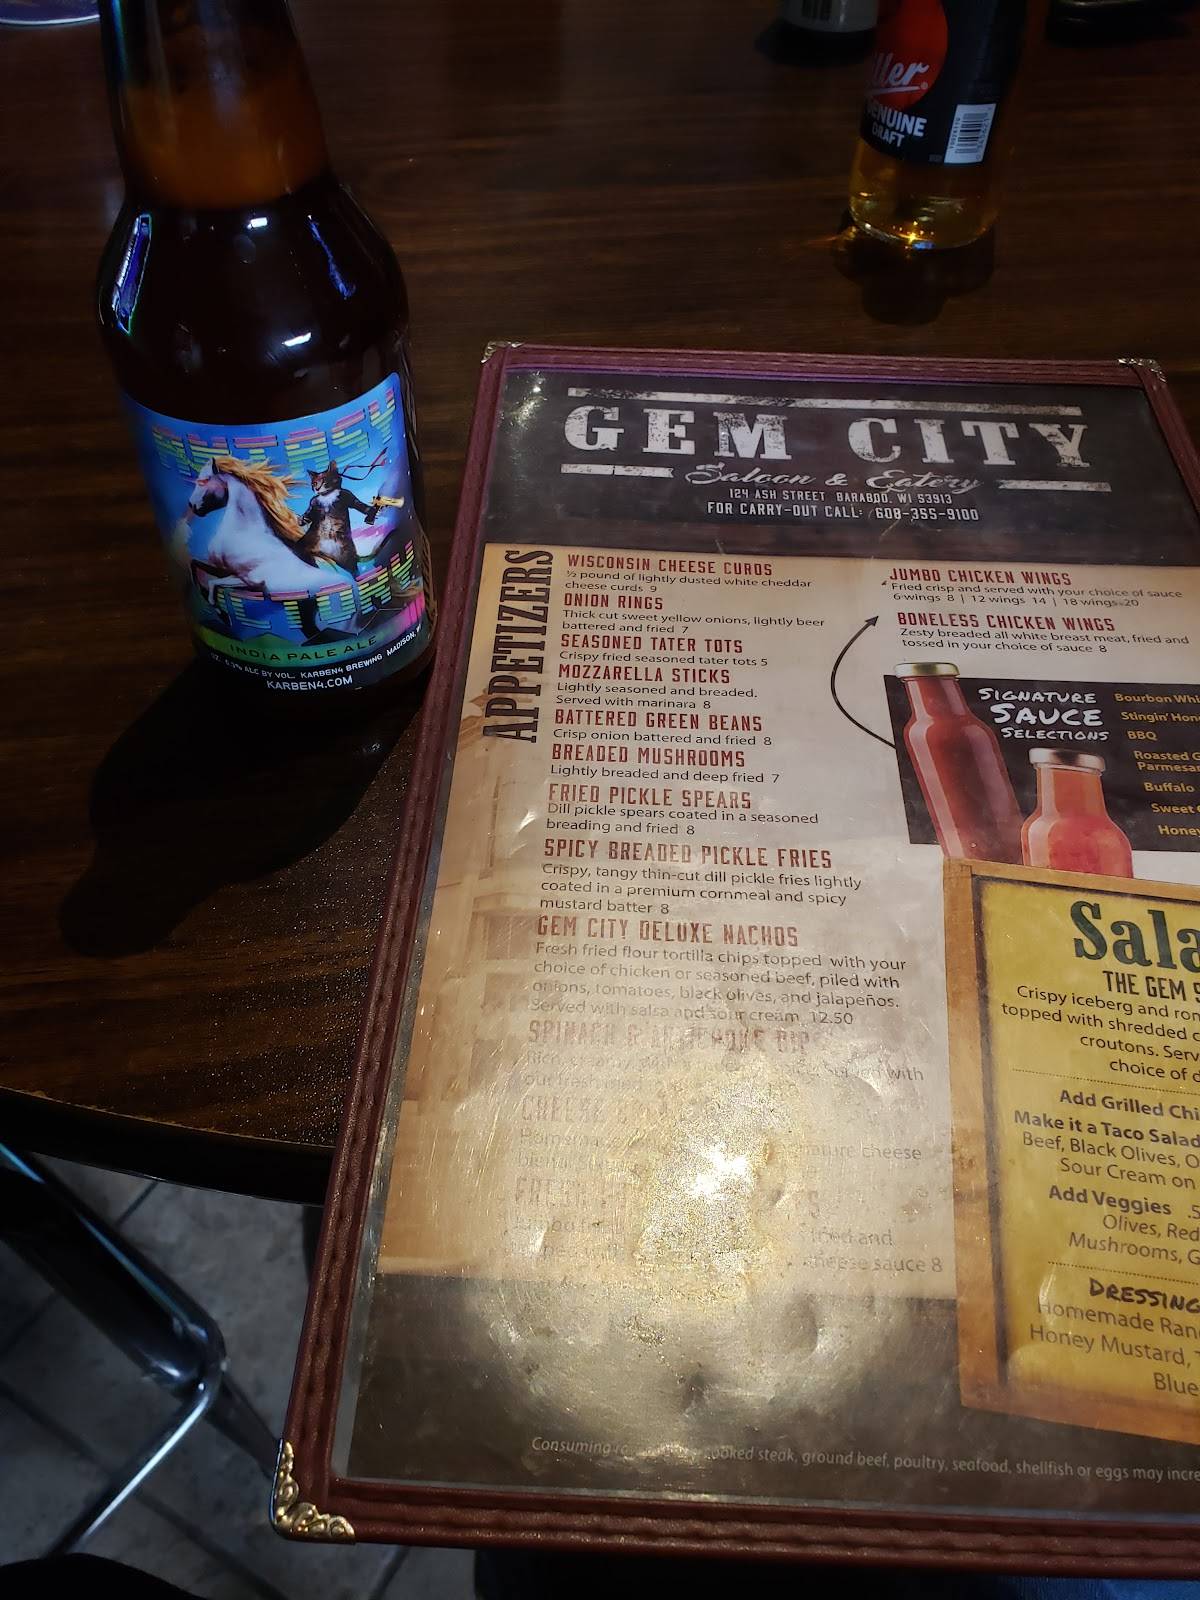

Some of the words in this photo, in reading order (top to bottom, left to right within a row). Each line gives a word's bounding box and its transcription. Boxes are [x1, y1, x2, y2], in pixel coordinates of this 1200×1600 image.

[872, 123, 905, 148] DRAFT
[564, 405, 792, 460] GEM
[848, 417, 1091, 468] CITY
[685, 462, 817, 487] Saloon
[824, 474, 849, 487] &
[866, 470, 985, 494] Eatery
[729, 488, 750, 500] 124
[754, 489, 778, 501] ASH
[783, 490, 826, 502] STREET
[898, 494, 912, 505] WI
[917, 494, 953, 505] 53913
[707, 501, 734, 515] FOR
[740, 503, 818, 518] CARRY-OUT
[824, 506, 863, 519] CALL:
[875, 508, 980, 522] 608-355-9100
[567, 554, 650, 570] WISCONSIN
[658, 559, 716, 574] CHEESE
[723, 562, 772, 576] CURDS
[889, 568, 941, 581] JUMBO
[947, 569, 1015, 583] CHICKEN
[1020, 571, 1071, 585] WINGS
[563, 592, 609, 607] ONION
[617, 595, 663, 610] RINGS
[897, 612, 979, 627] BONELESS
[985, 614, 1056, 630] CHICKEN
[1061, 617, 1115, 631] WINGS
[230, 643, 281, 662] INDIA
[287, 648, 338, 661] PALE
[343, 635, 379, 655] ALE
[261, 670, 274, 678] BY
[300, 665, 344, 680] KARBEN4
[345, 653, 383, 673] BREWING
[386, 631, 417, 657] MADISON,
[483, 549, 554, 743] APPETIZERS
[560, 633, 642, 649] SEASONED
[650, 636, 696, 651] TATER
[704, 638, 742, 653] TOTS
[559, 650, 599, 666] Crispy
[602, 652, 631, 662] fried
[634, 655, 695, 664] seasoned
[698, 657, 729, 665] tater
[732, 657, 757, 666] tots
[760, 658, 768, 666] 5
[266, 675, 354, 691] KARBEN4.COM
[558, 664, 663, 681] MOZZARELLA
[671, 667, 730, 683] STICKS
[557, 682, 602, 696] Lightly
[605, 685, 666, 696] seasoned
[669, 686, 695, 696] and
[698, 687, 757, 697] breaded.
[978, 687, 1097, 704] SIGNATURE
[1114, 693, 1173, 703] Bourbon
[1174, 694, 1200, 704] Whi
[554, 708, 637, 726] BATTERED
[645, 712, 699, 729] GREEN
[708, 714, 762, 731] BEANS
[990, 703, 1103, 726] SAUCE
[553, 728, 587, 741] Crisp
[590, 730, 629, 740] onion
[633, 731, 692, 743] battered
[695, 734, 721, 744] and
[724, 734, 756, 745] fried
[763, 736, 772, 746] 8
[1001, 727, 1110, 742] SELECTIONS
[1127, 730, 1159, 741] BBQ
[551, 743, 628, 762] BREADED
[637, 747, 745, 767] MUSHROOMS
[1133, 750, 1190, 761] Roasted
[550, 764, 598, 778] Lightly
[601, 766, 659, 779] breaded
[662, 770, 689, 780] and
[692, 770, 728, 783] deep
[731, 771, 764, 783] fried
[771, 773, 780, 783] 7
[548, 783, 599, 805] FRIED
[609, 786, 673, 806] PICKLE
[681, 789, 751, 809] SPEARS
[1143, 781, 1196, 793] Buffalo
[1150, 802, 1196, 814] Sweet
[544, 838, 598, 858] SPICY
[608, 841, 691, 862] BREADED
[701, 845, 768, 866] PICKLE
[777, 848, 832, 868] FRIES
[537, 914, 577, 936] GEM
[587, 917, 628, 939] CITY
[639, 920, 713, 943] DELUXE
[723, 924, 798, 947] NACHOS
[1101, 970, 1140, 995] THE
[1144, 975, 1187, 1001] GEM
[1016, 985, 1067, 1006] Crispy
[1071, 992, 1133, 1015] iceberg
[1137, 1004, 1169, 1017] and
[1001, 1003, 1062, 1022] topped
[1066, 1013, 1103, 1028] with
[1108, 1017, 1187, 1040] shredded
[1080, 1034, 1160, 1057] croutons.
[1163, 1045, 1200, 1062] Serv
[1109, 1058, 1165, 1079] choice
[1170, 1067, 1188, 1081] of
[1059, 1089, 1096, 1107] Add
[1101, 1095, 1164, 1116] Grilled
[1168, 1104, 1200, 1121] Chi
[1014, 1110, 1064, 1129] Make
[1068, 1117, 1082, 1132] it
[1086, 1123, 1097, 1134] a
[1100, 1121, 1144, 1140] Taco
[1148, 1128, 1200, 1149] Salad
[1022, 1131, 1065, 1152] Beef,
[1069, 1137, 1117, 1157] Black
[1120, 1145, 1180, 1168] Olives,
[1059, 1157, 1102, 1176] Sour
[1106, 1163, 1166, 1185] Cream
[1171, 1176, 1196, 1189] on
[1048, 1185, 1088, 1203] Add
[1090, 1190, 1172, 1215] Veggies
[1102, 1214, 1162, 1239] Olives,
[1166, 1222, 1200, 1242] Red
[1069, 1231, 1183, 1265] Mushrooms,
[1089, 1277, 1200, 1314] DRESSING
[1038, 1299, 1155, 1332] Homemade
[1160, 1316, 1200, 1340] Ran
[1029, 1323, 1095, 1354] Honey
[1101, 1334, 1191, 1369] Mustard,
[1153, 1371, 1199, 1397] Blue
[758, 1449, 798, 1464] steak,
[802, 1449, 853, 1467] ground
[857, 1451, 889, 1468] beef,
[894, 1454, 949, 1472] poultry,
[951, 1457, 1012, 1475] seafood,
[1016, 1459, 1073, 1477] shellfish
[1077, 1465, 1091, 1477] or
[1095, 1466, 1130, 1482] eggs
[1132, 1467, 1164, 1483] may
